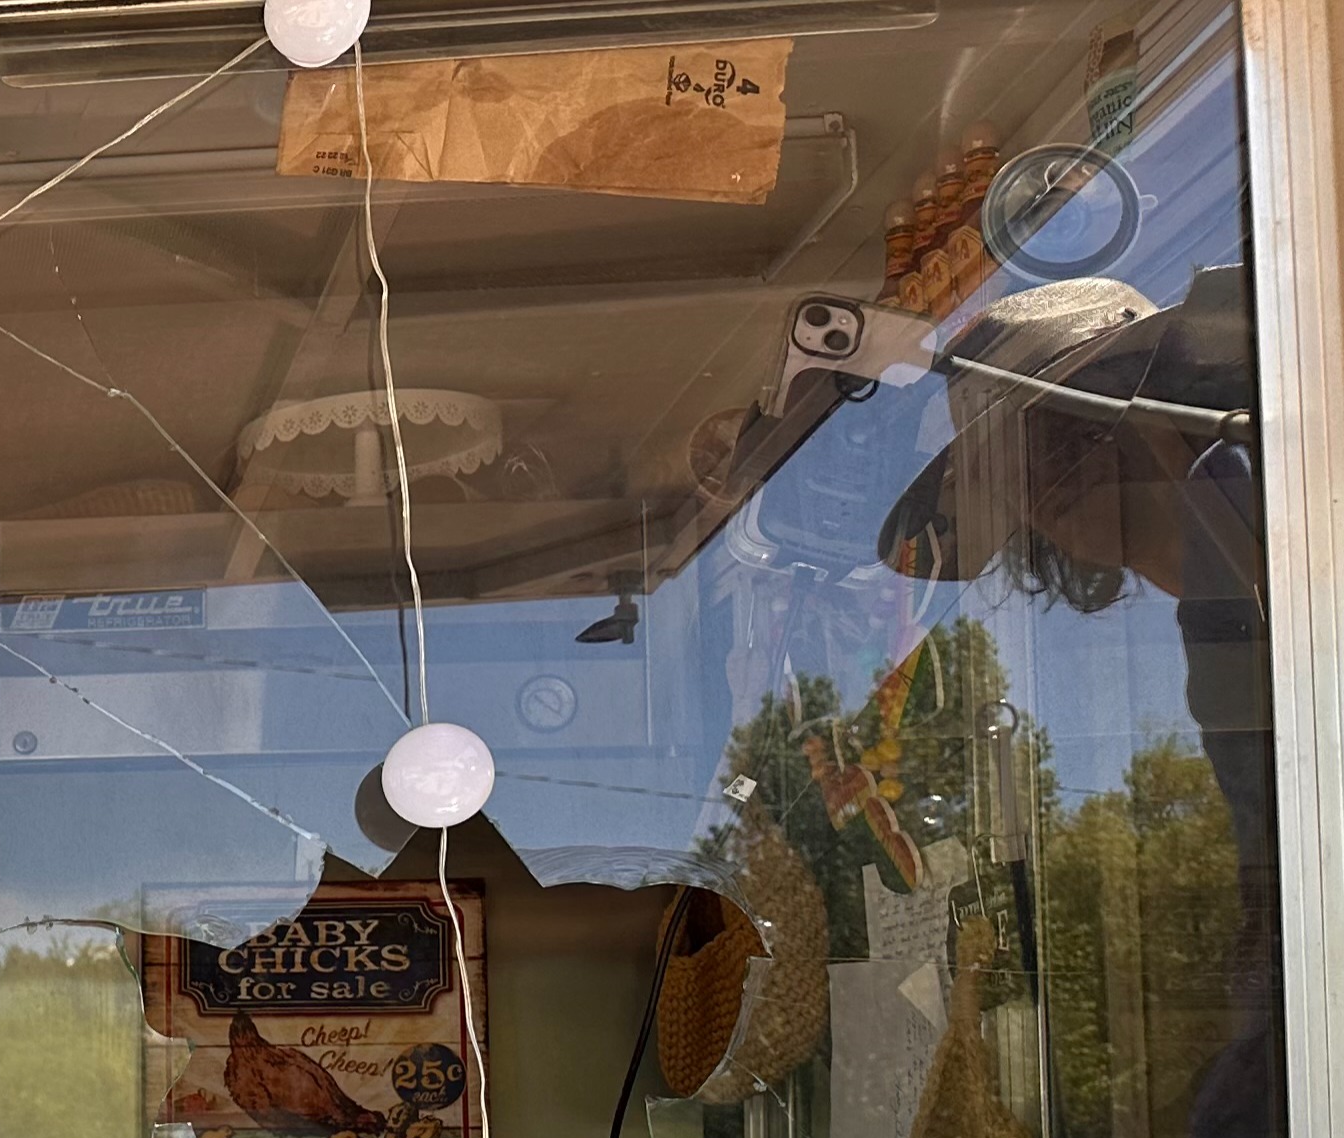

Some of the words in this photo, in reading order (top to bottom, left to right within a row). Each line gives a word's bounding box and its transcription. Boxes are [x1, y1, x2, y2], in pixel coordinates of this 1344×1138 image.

[712, 59, 728, 107] DURO
[736, 78, 760, 95] 4
[88, 613, 191, 628] REFRIGERATOR
[247, 919, 379, 948] BABY
[218, 944, 411, 974] CHICKS
[237, 977, 297, 999] for
[310, 975, 391, 999] sale
[301, 1020, 372, 1047] Cheep!
